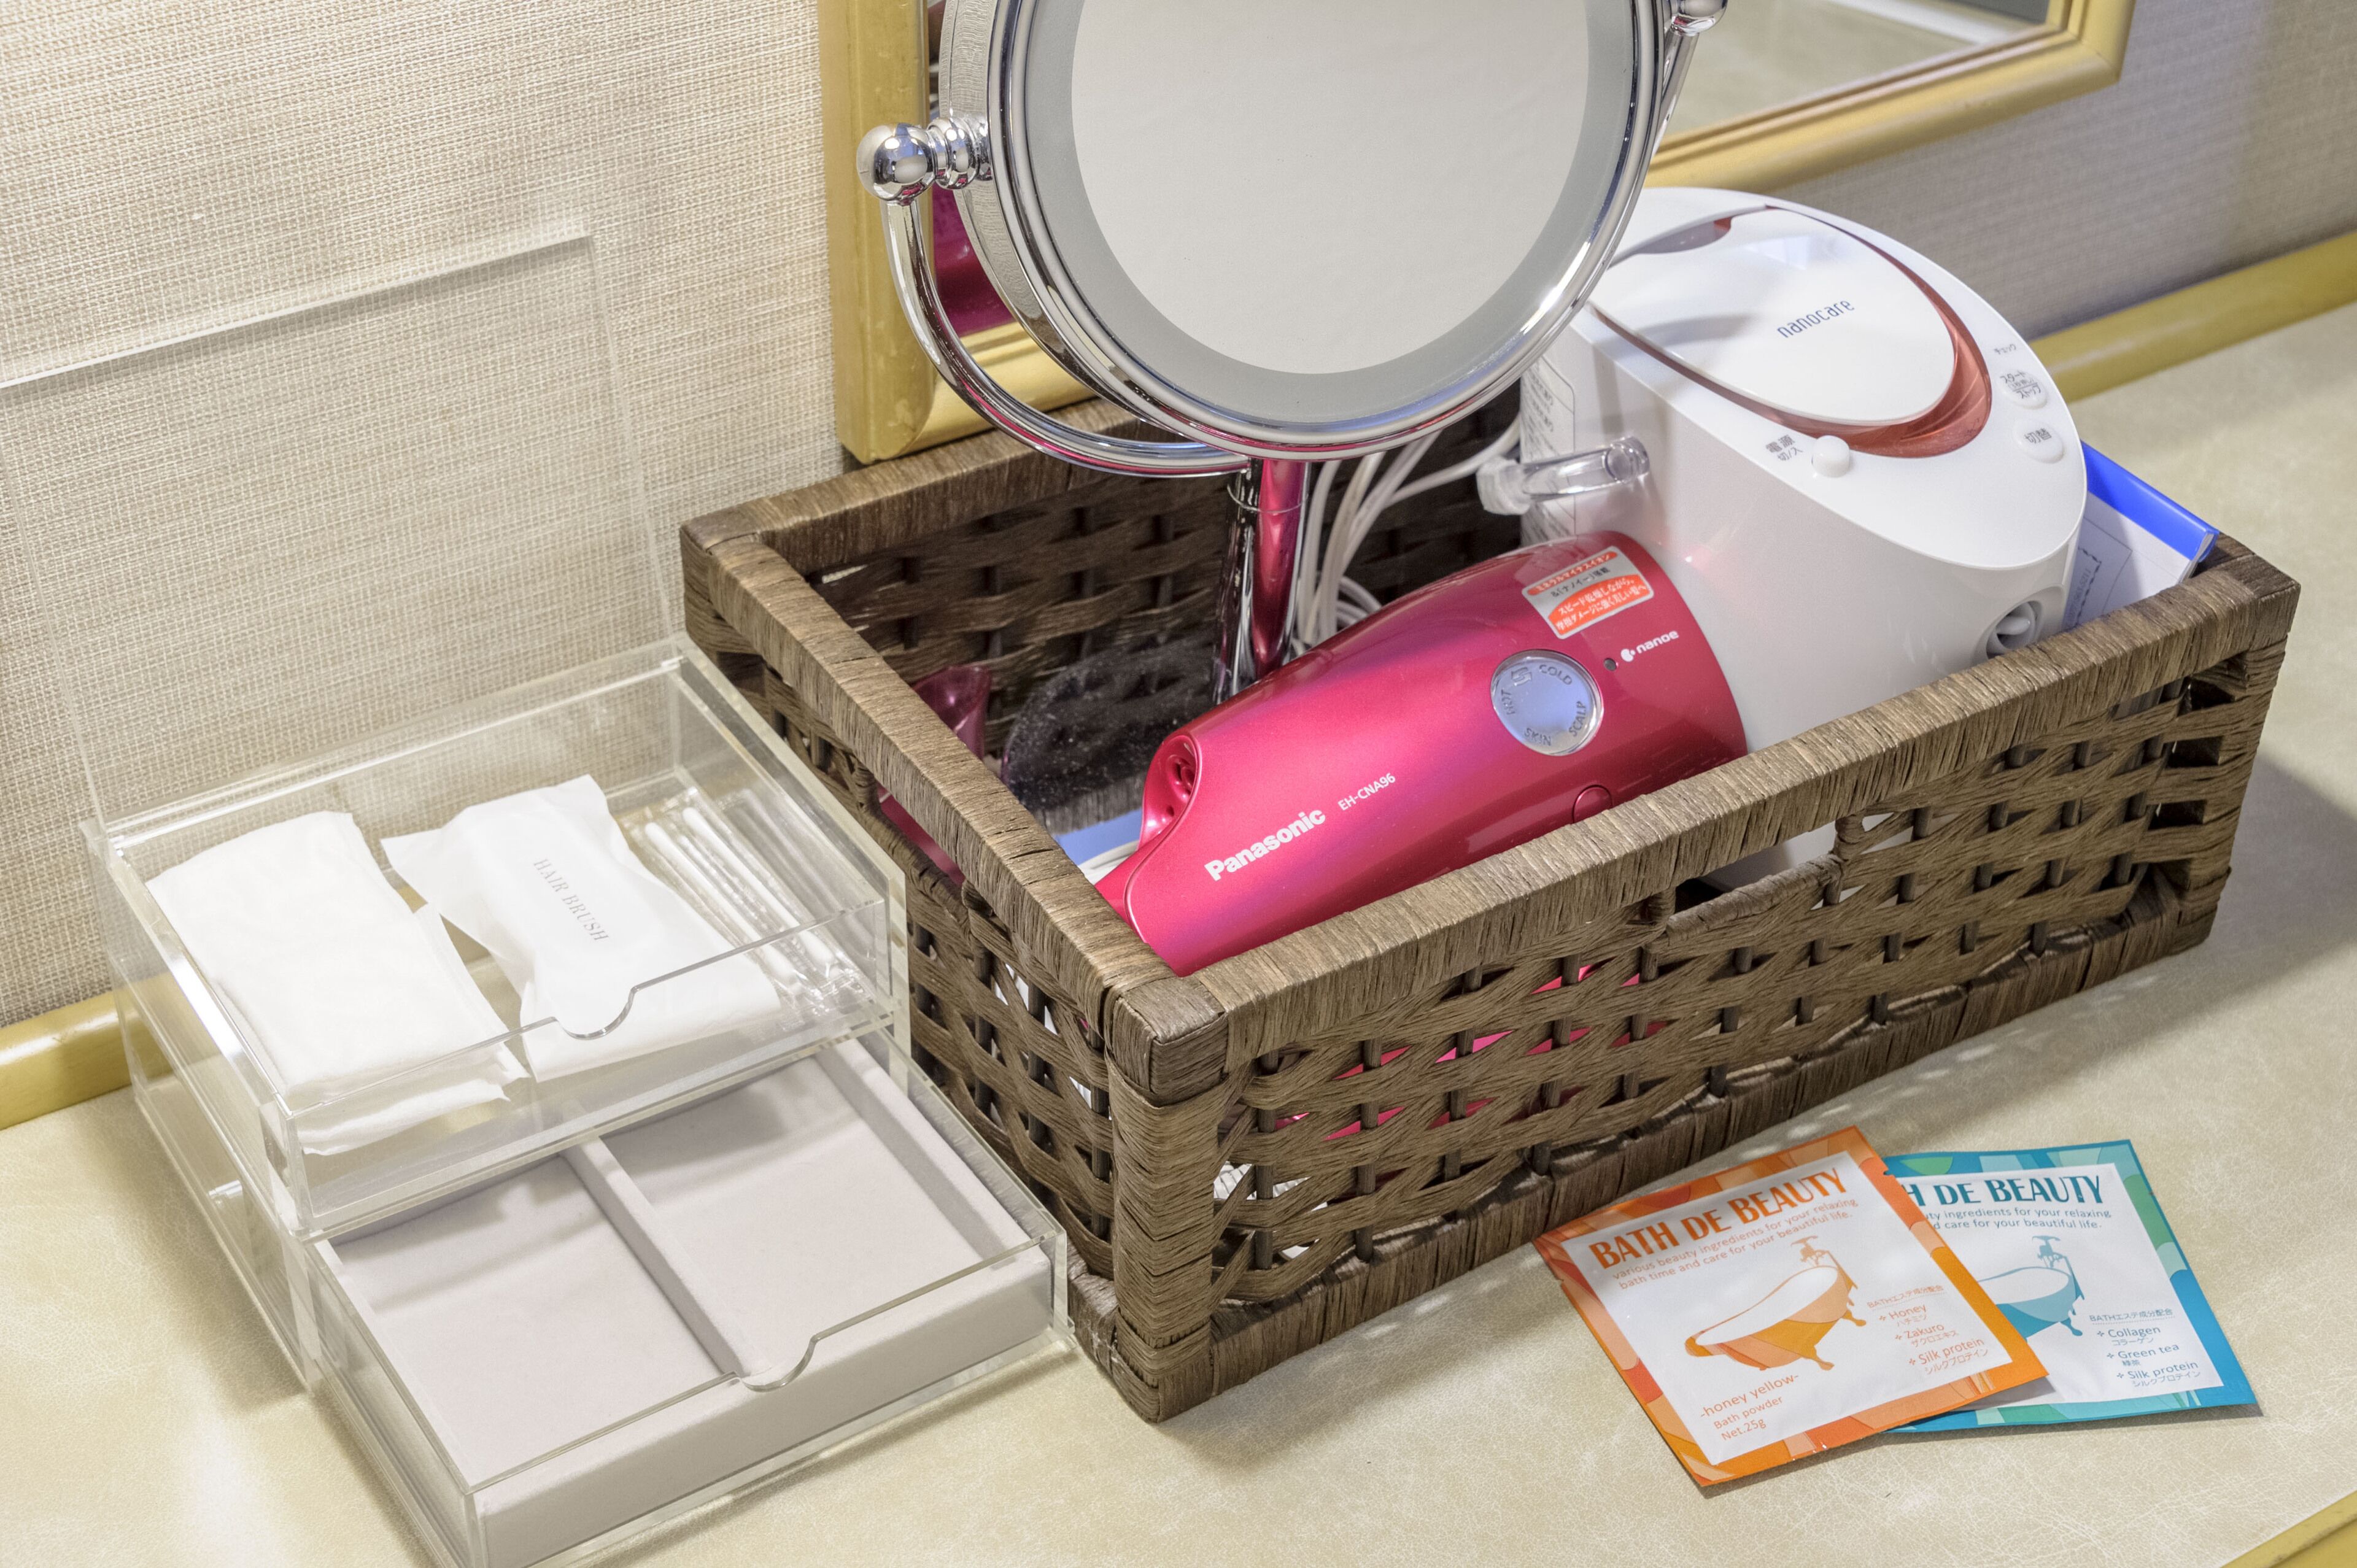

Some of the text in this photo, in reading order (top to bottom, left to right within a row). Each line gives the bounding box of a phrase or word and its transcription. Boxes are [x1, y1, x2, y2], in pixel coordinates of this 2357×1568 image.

[1777, 301, 1854, 338] nanocare
[1765, 434, 1796, 453] 電源
[2025, 428, 2052, 444] 切替
[1536, 554, 1610, 590] ミネラルマイナスイオン
[1636, 630, 1679, 654] nanoe
[1539, 664, 1573, 685] COLD
[1501, 689, 1516, 716] HOT
[1569, 700, 1587, 737] SCALP
[1524, 728, 1552, 746] SKIN
[1337, 773, 1396, 811] EH-CNA96
[1204, 809, 1326, 881] Panasonic
[533, 859, 610, 940] HAIR BRUSH
[1933, 1183, 1981, 1205] DE
[1984, 1175, 2103, 1203] BEAUTY
[1589, 1221, 1680, 1270] BATH
[1681, 1209, 1732, 1241] DE
[1727, 1167, 1847, 1224] BEAUTY
[1944, 1208, 2011, 1219] ingredients
[2014, 1207, 2030, 1216] for
[2035, 1208, 2061, 1218] your
[2065, 1209, 2111, 1218] relaxing
[1973, 1219, 1989, 1228] for
[1994, 1219, 2020, 1229] your
[2025, 1219, 2075, 1228] beautiful
[2080, 1221, 2102, 1229] life.
[1612, 1199, 1859, 1280] various beauty ingredients for your relaxing
[1619, 1210, 1852, 1290] bath time and care for your beautiful life.
[1867, 1285, 1944, 1308] BATHエステ成分配合
[1888, 1304, 1927, 1320] Honey
[1896, 1315, 1927, 1327] ハチミツ
[2089, 1308, 2173, 1321] BATHエステ成分配合
[1904, 1324, 1945, 1339] Zakuro
[1911, 1330, 1959, 1348] ザクロエキス
[2108, 1326, 2161, 1338] Collagen
[2111, 1337, 2154, 1346] コラーゲン
[1918, 1338, 1984, 1365] Silk protein
[1924, 1349, 1988, 1375] シルクプロテイン
[2118, 1344, 2180, 1359] Green tea
[2127, 1361, 2199, 1380] Silk protein
[2132, 1372, 2200, 1388] シルクプロテイン
[1714, 1396, 1783, 1429] Bath powder
[1721, 1419, 1767, 1440] Net.25g
